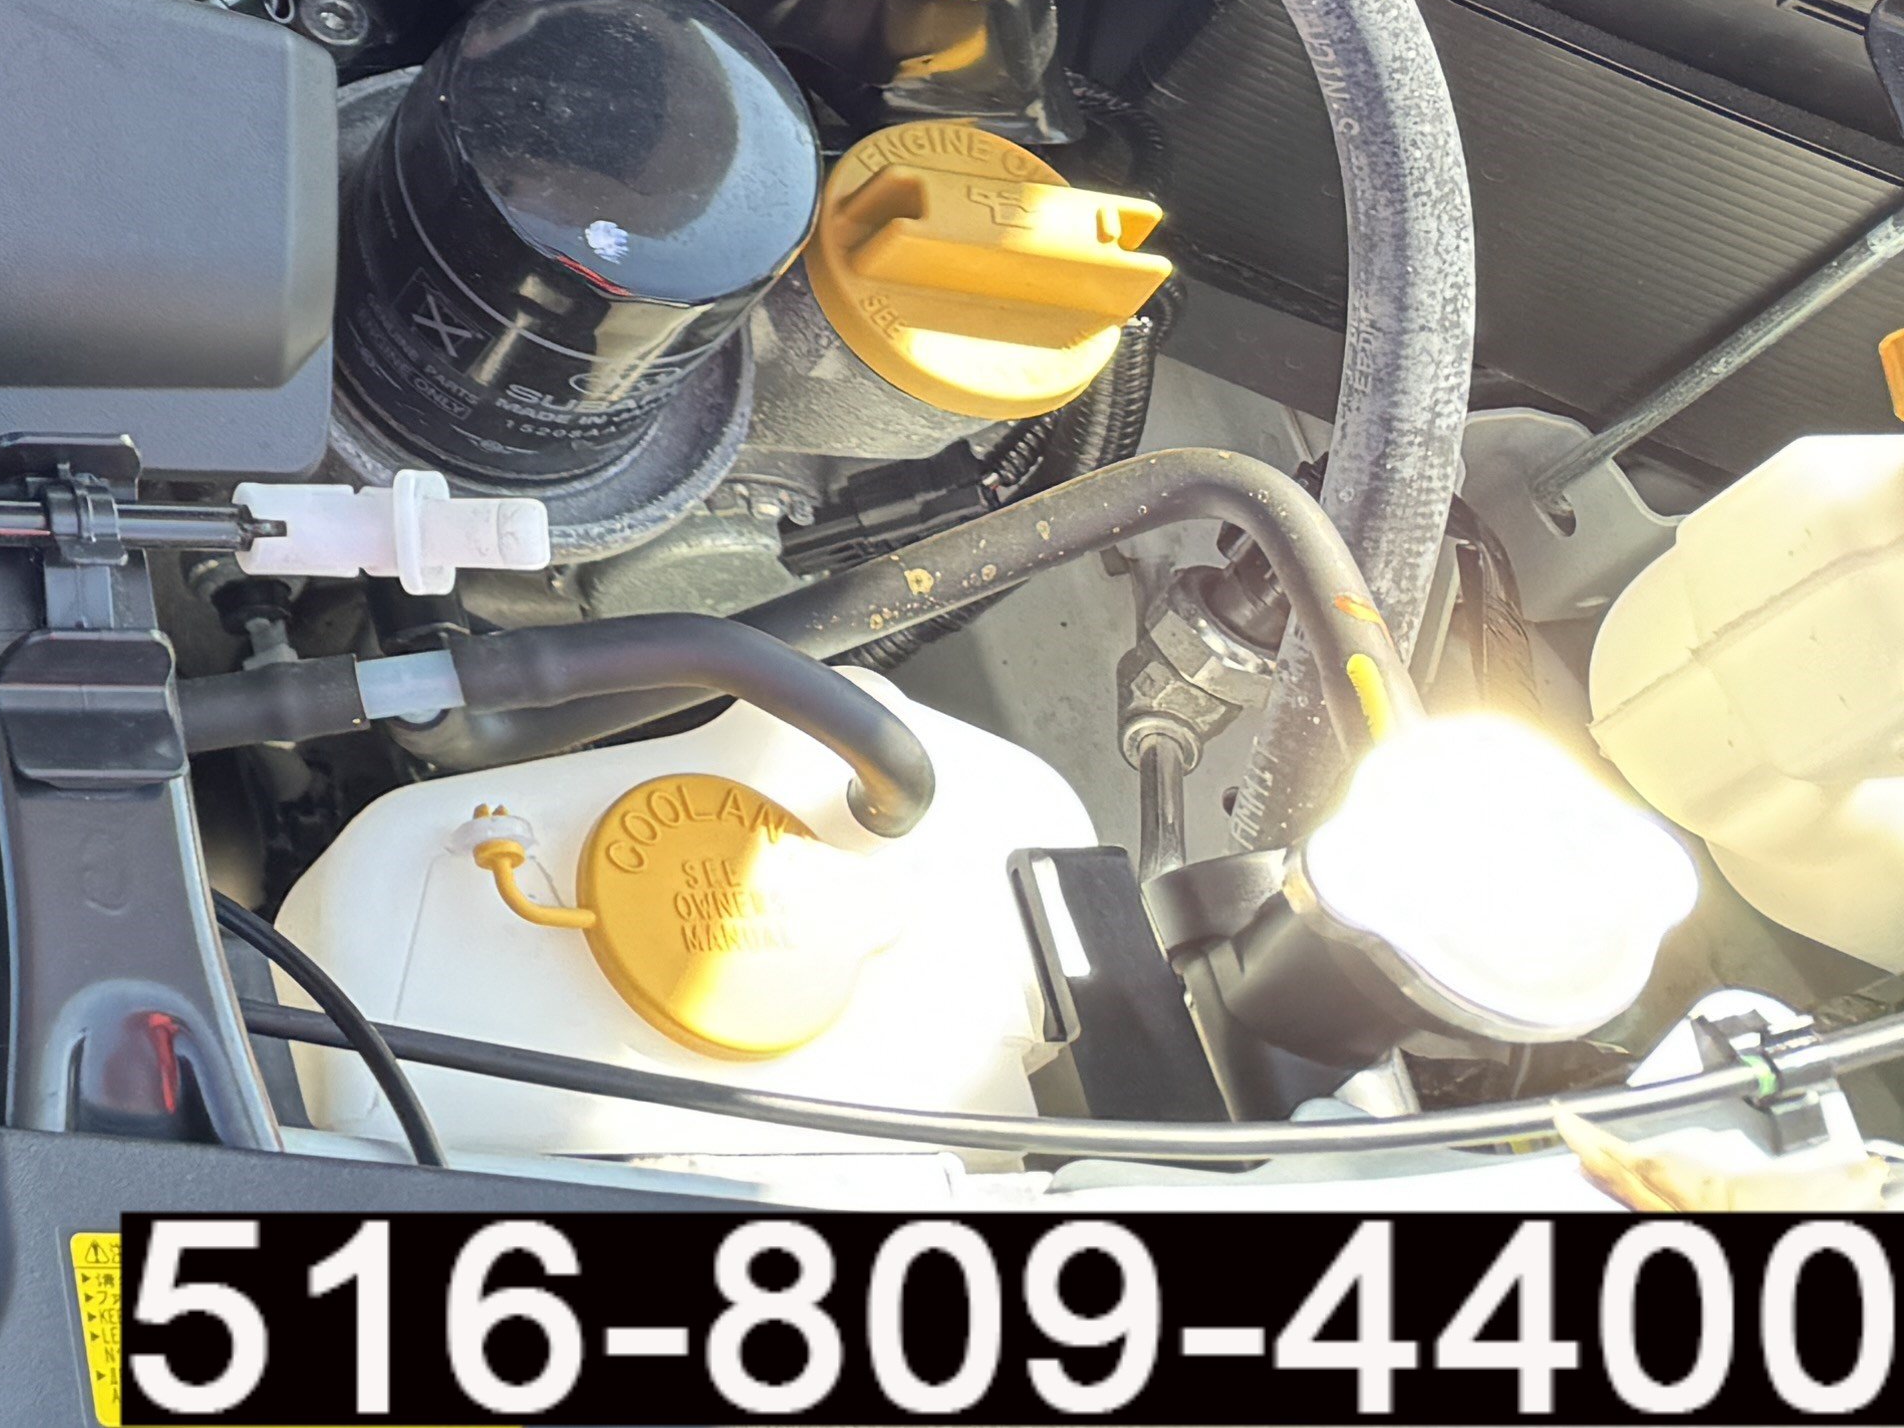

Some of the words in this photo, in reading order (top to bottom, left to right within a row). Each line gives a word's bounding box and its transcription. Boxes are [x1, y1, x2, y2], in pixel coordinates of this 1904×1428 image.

[855, 126, 991, 174] ENGINE
[605, 784, 790, 874] COOLAN
[679, 857, 742, 890] SEE
